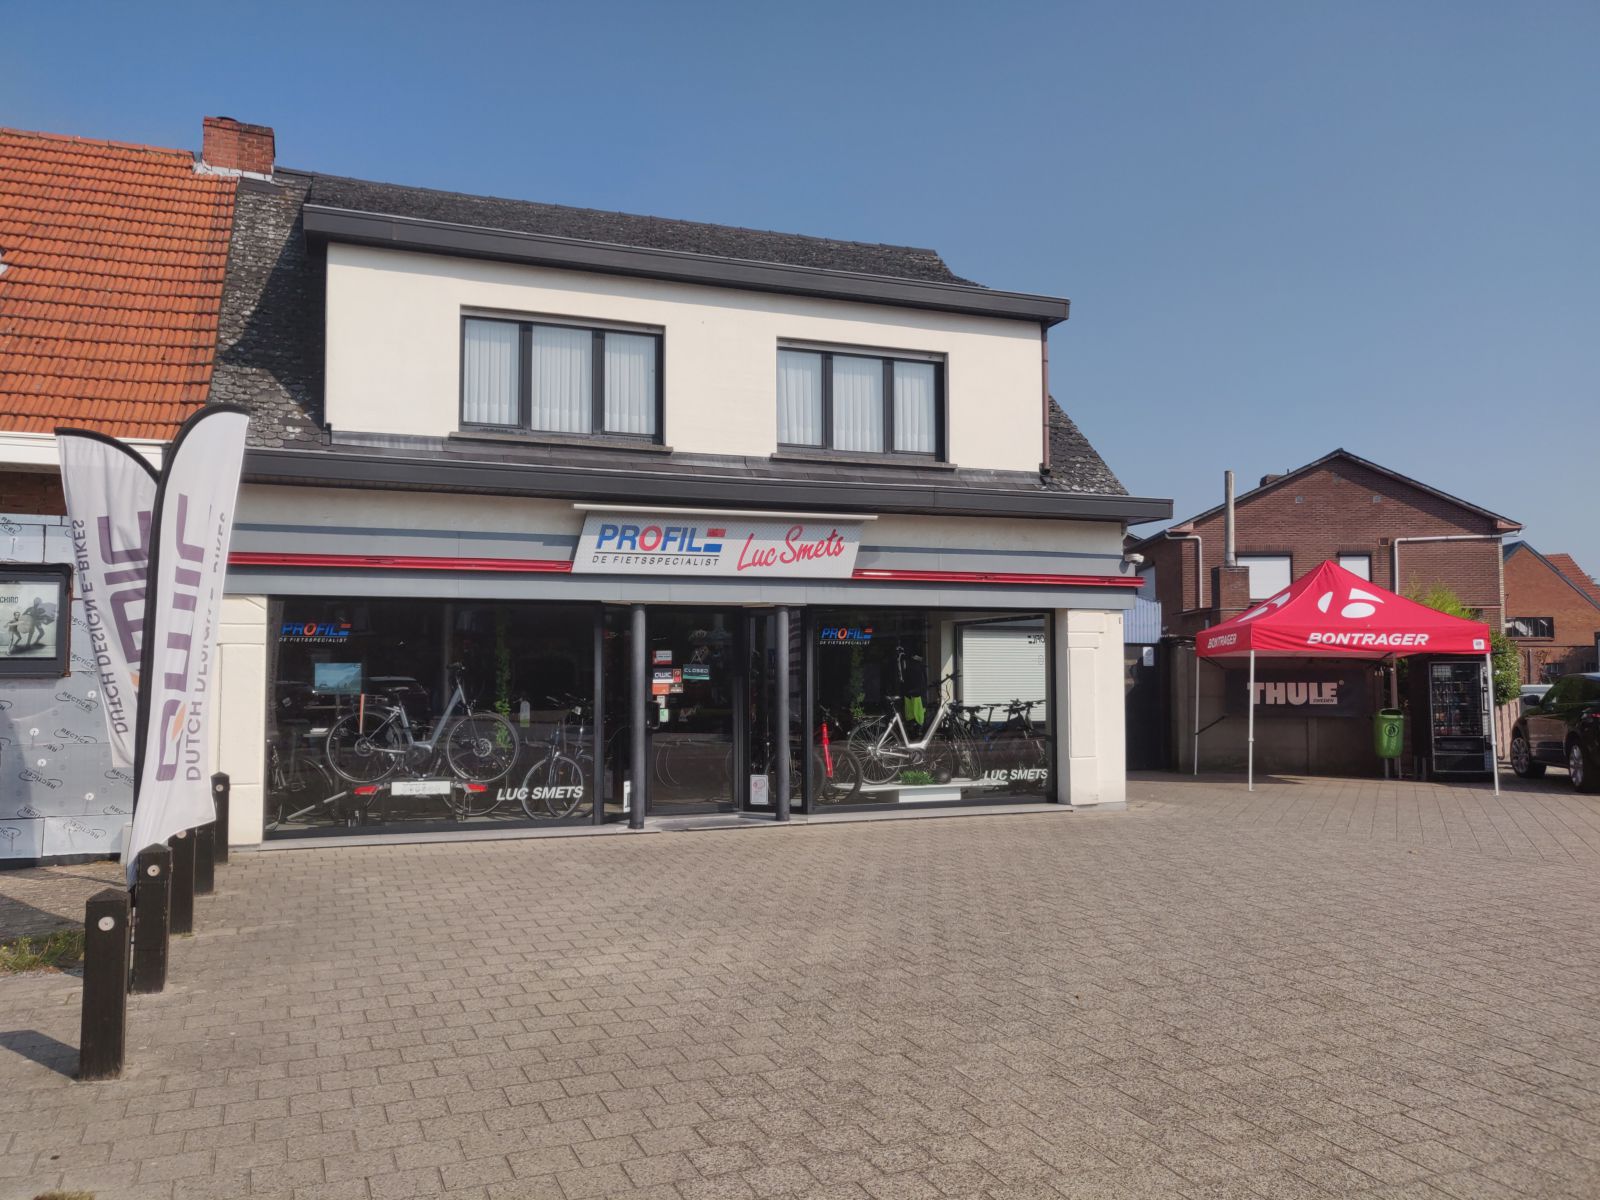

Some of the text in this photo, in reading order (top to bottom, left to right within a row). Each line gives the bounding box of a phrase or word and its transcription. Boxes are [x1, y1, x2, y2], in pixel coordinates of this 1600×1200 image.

[595, 524, 703, 552] PROFIL
[737, 525, 845, 571] Luc Smets
[592, 556, 720, 567] DE FIETSSPECIALIST
[281, 623, 340, 636] PROFIL
[821, 627, 864, 639] PROFIL
[1307, 632, 1430, 646] BONTRAGER
[1247, 682, 1338, 706] THULE
[185, 701, 203, 781] DUTCH
[984, 768, 1049, 781] LUC SMETS
[496, 785, 584, 801] LUC SMETS
